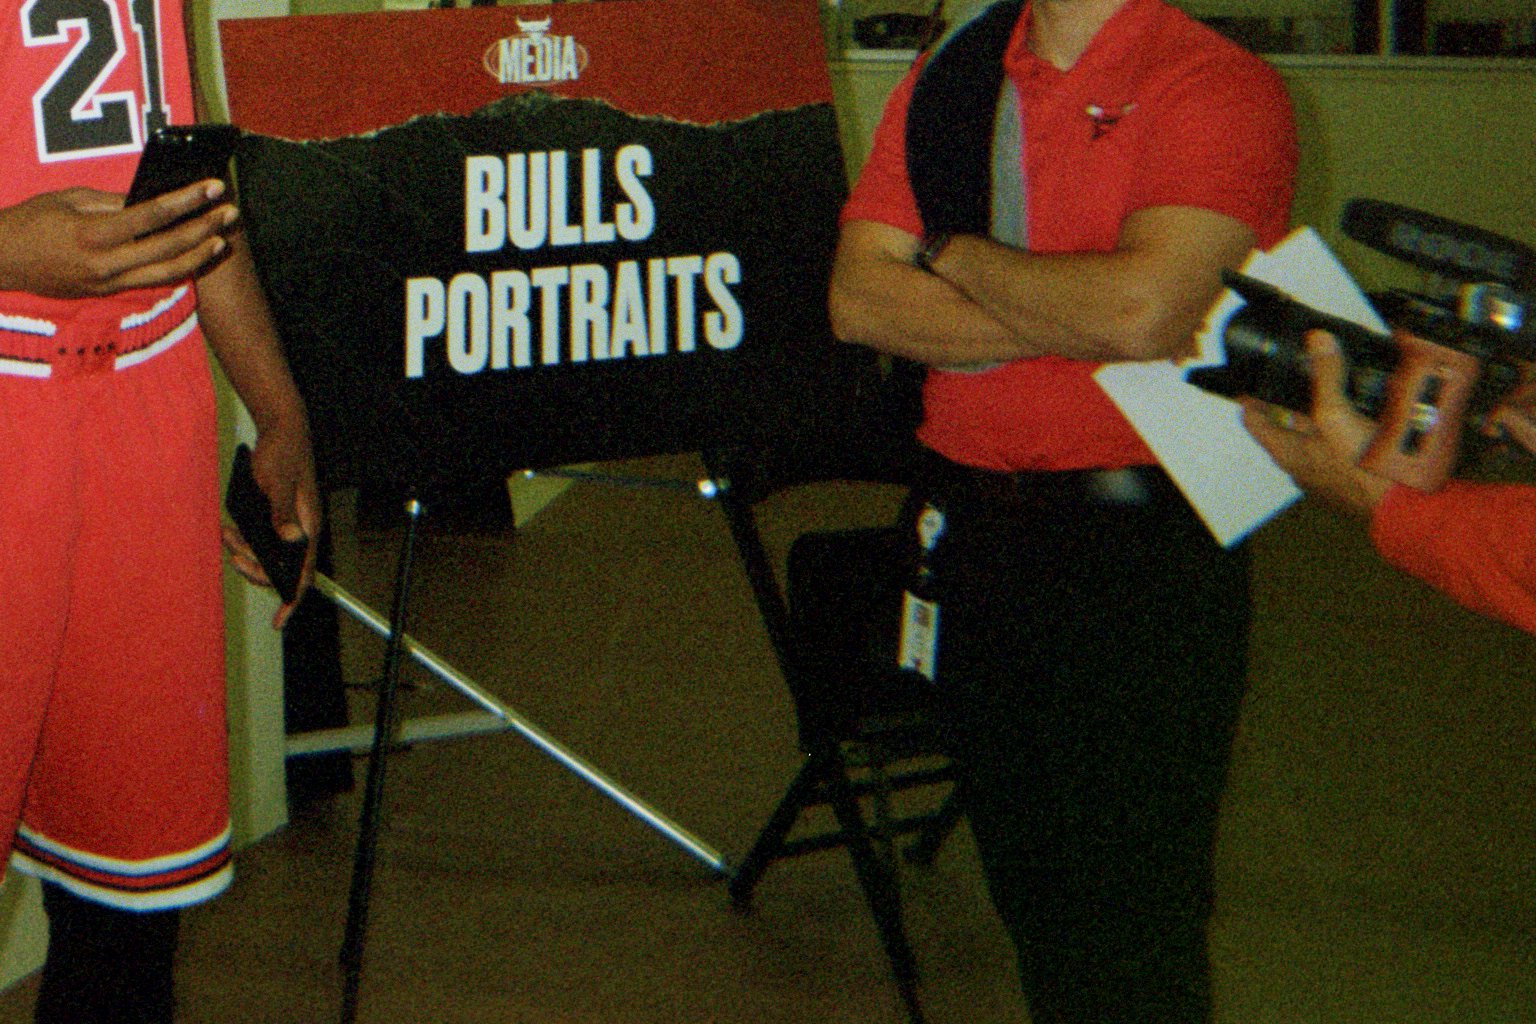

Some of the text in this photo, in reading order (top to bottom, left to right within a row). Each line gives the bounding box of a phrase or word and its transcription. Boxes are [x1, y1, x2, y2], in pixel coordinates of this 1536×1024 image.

[497, 36, 580, 84] MEDIA
[464, 144, 657, 254] BULLS
[405, 252, 745, 378] PORTRAITS
